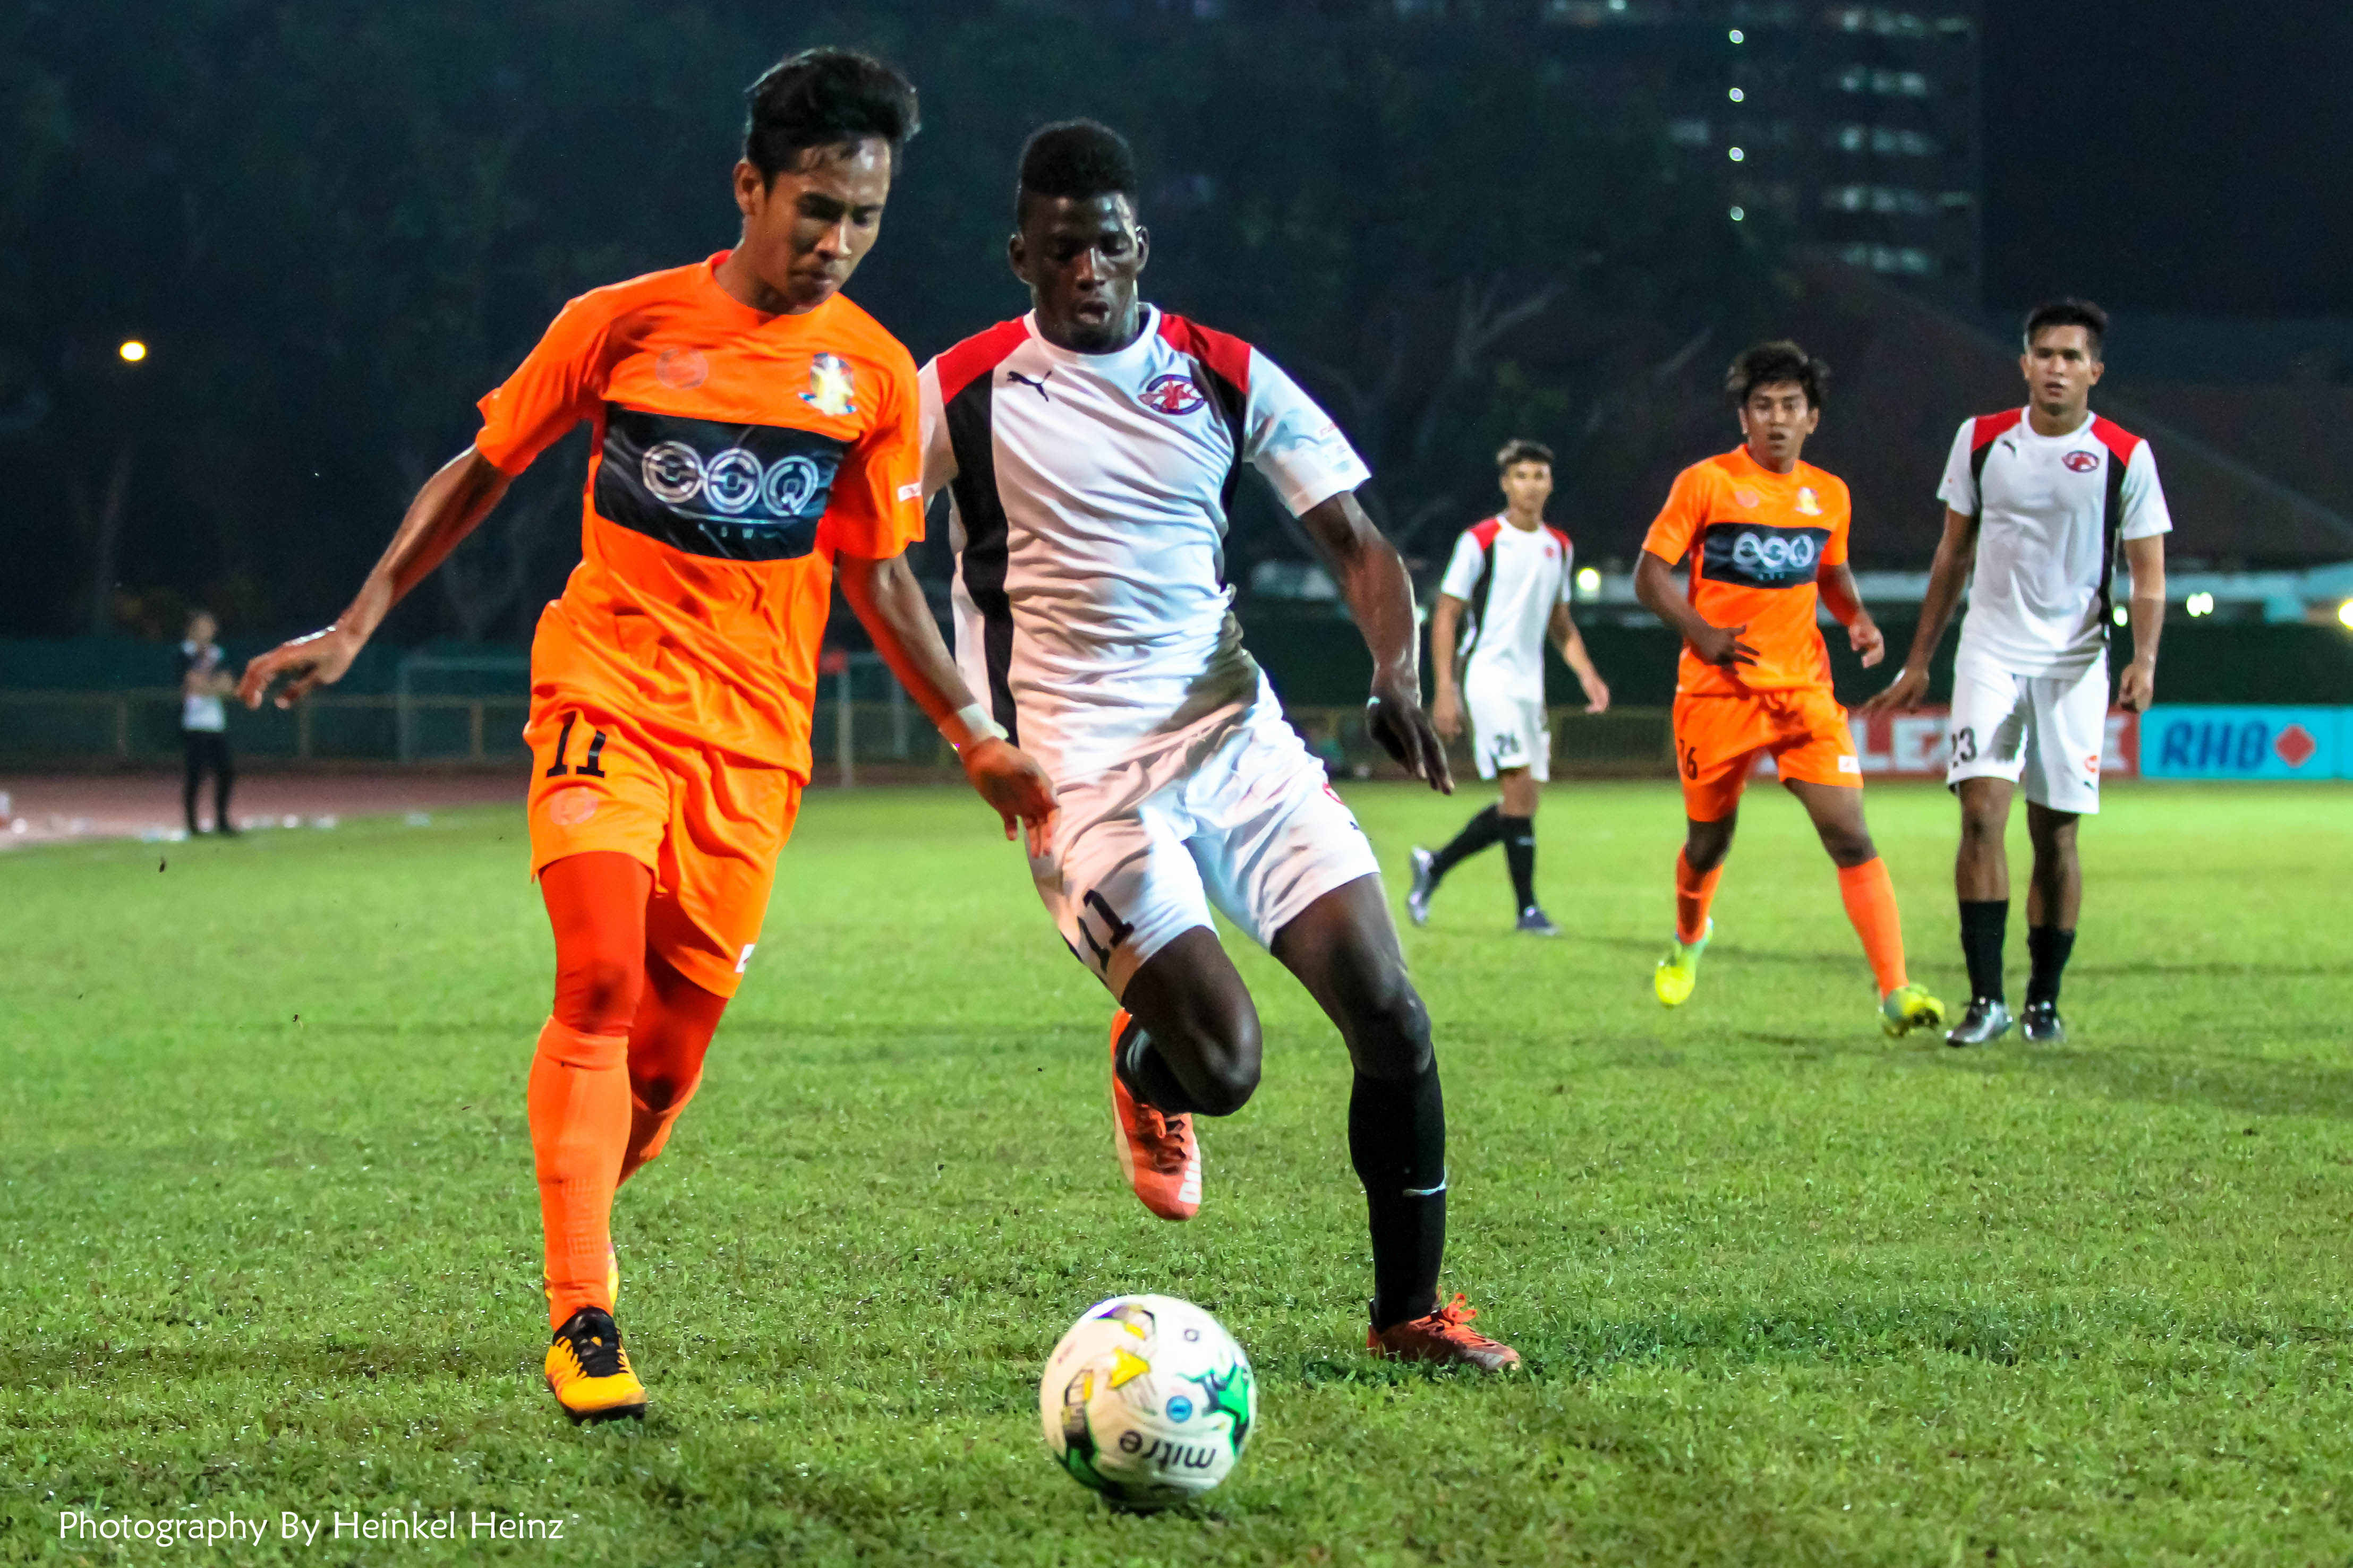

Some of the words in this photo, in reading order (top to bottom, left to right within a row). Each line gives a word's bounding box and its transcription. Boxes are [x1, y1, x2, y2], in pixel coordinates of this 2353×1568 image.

[546, 712, 606, 778] 11
[2161, 719, 2269, 770] RHB
[1077, 888, 1135, 973] 11
[1119, 1429, 1216, 1472] mitre
